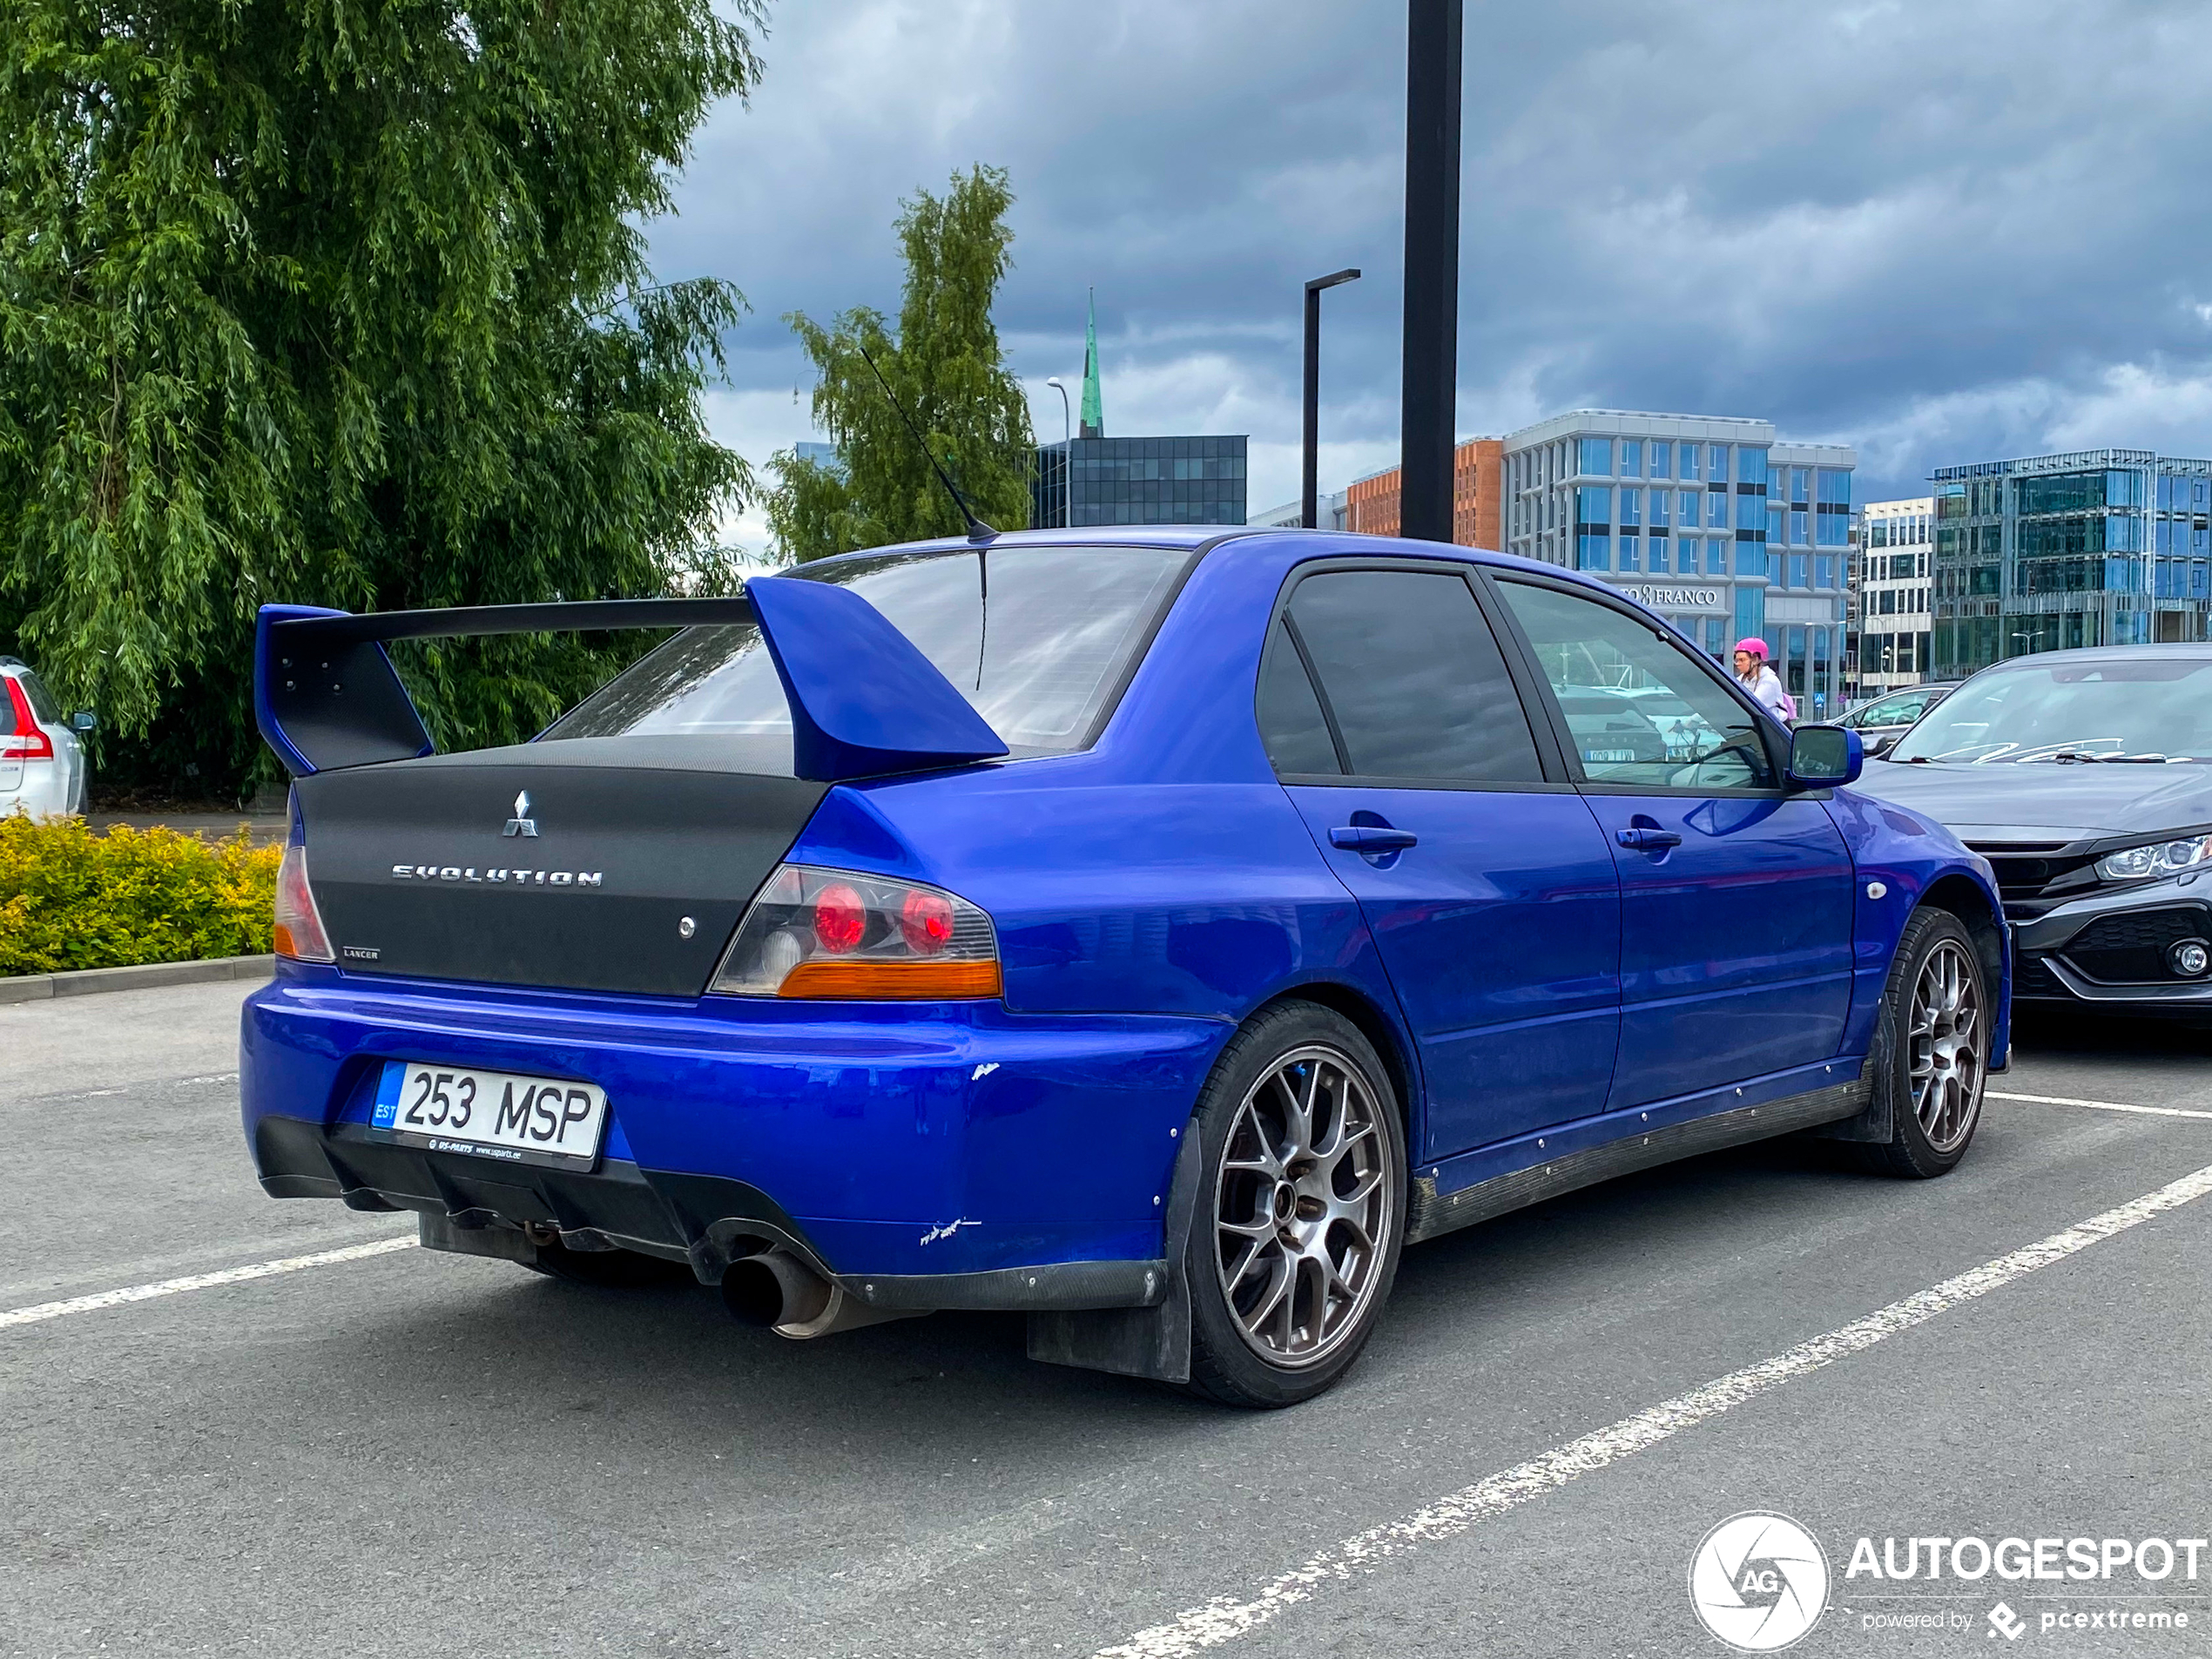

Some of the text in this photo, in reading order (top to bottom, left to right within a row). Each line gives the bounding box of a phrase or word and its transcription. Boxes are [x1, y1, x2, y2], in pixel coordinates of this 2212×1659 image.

[1655, 589, 1716, 604] FRANCO
[392, 864, 603, 887] EVOLUTION
[344, 949, 378, 960] LANCER
[375, 1103, 396, 1120] EST
[405, 1072, 591, 1143] 253 MSP
